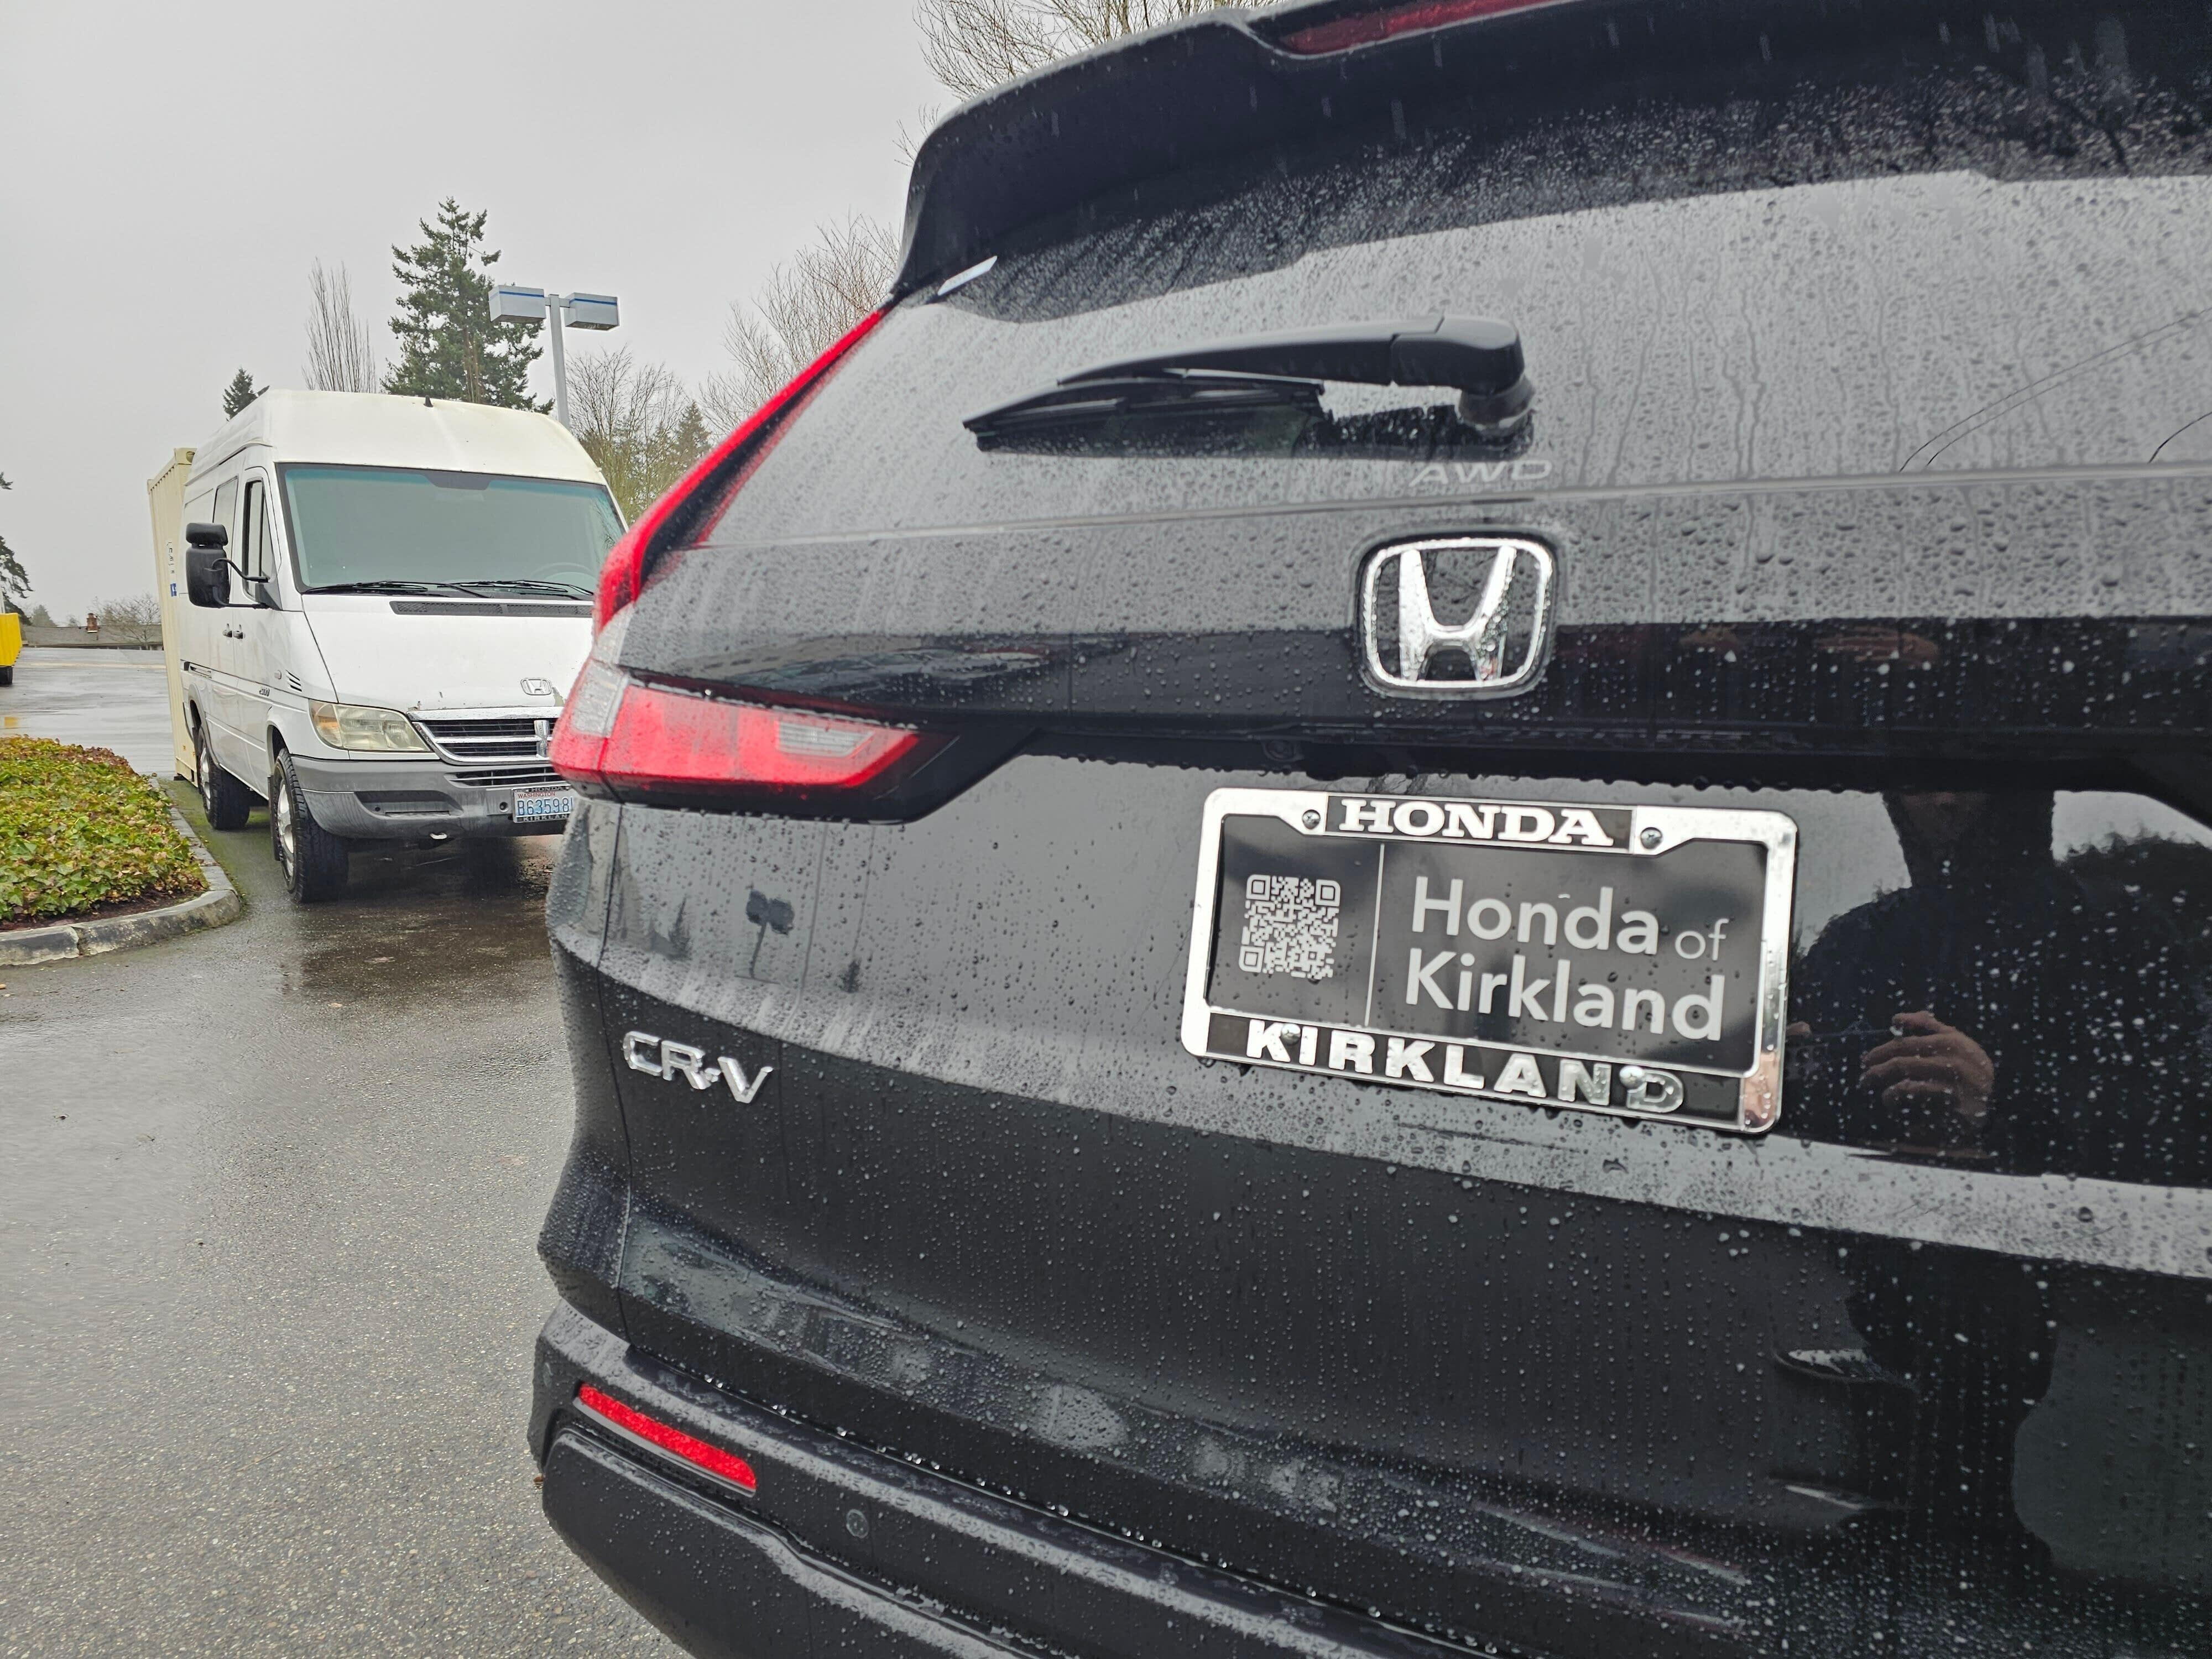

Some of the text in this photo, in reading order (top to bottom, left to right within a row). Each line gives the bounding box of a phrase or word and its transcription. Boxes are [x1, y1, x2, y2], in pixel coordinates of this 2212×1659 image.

[1408, 460, 1553, 487] AWD
[517, 797, 573, 816] B63598
[523, 813, 568, 822] KIRKLAN
[1340, 798, 1614, 847] HONDA
[1411, 875, 1730, 962] Honda of
[1405, 947, 1726, 1042] Kirkland
[623, 1031, 774, 1104] CR-V
[1245, 1019, 1684, 1114] KIRKLAND
